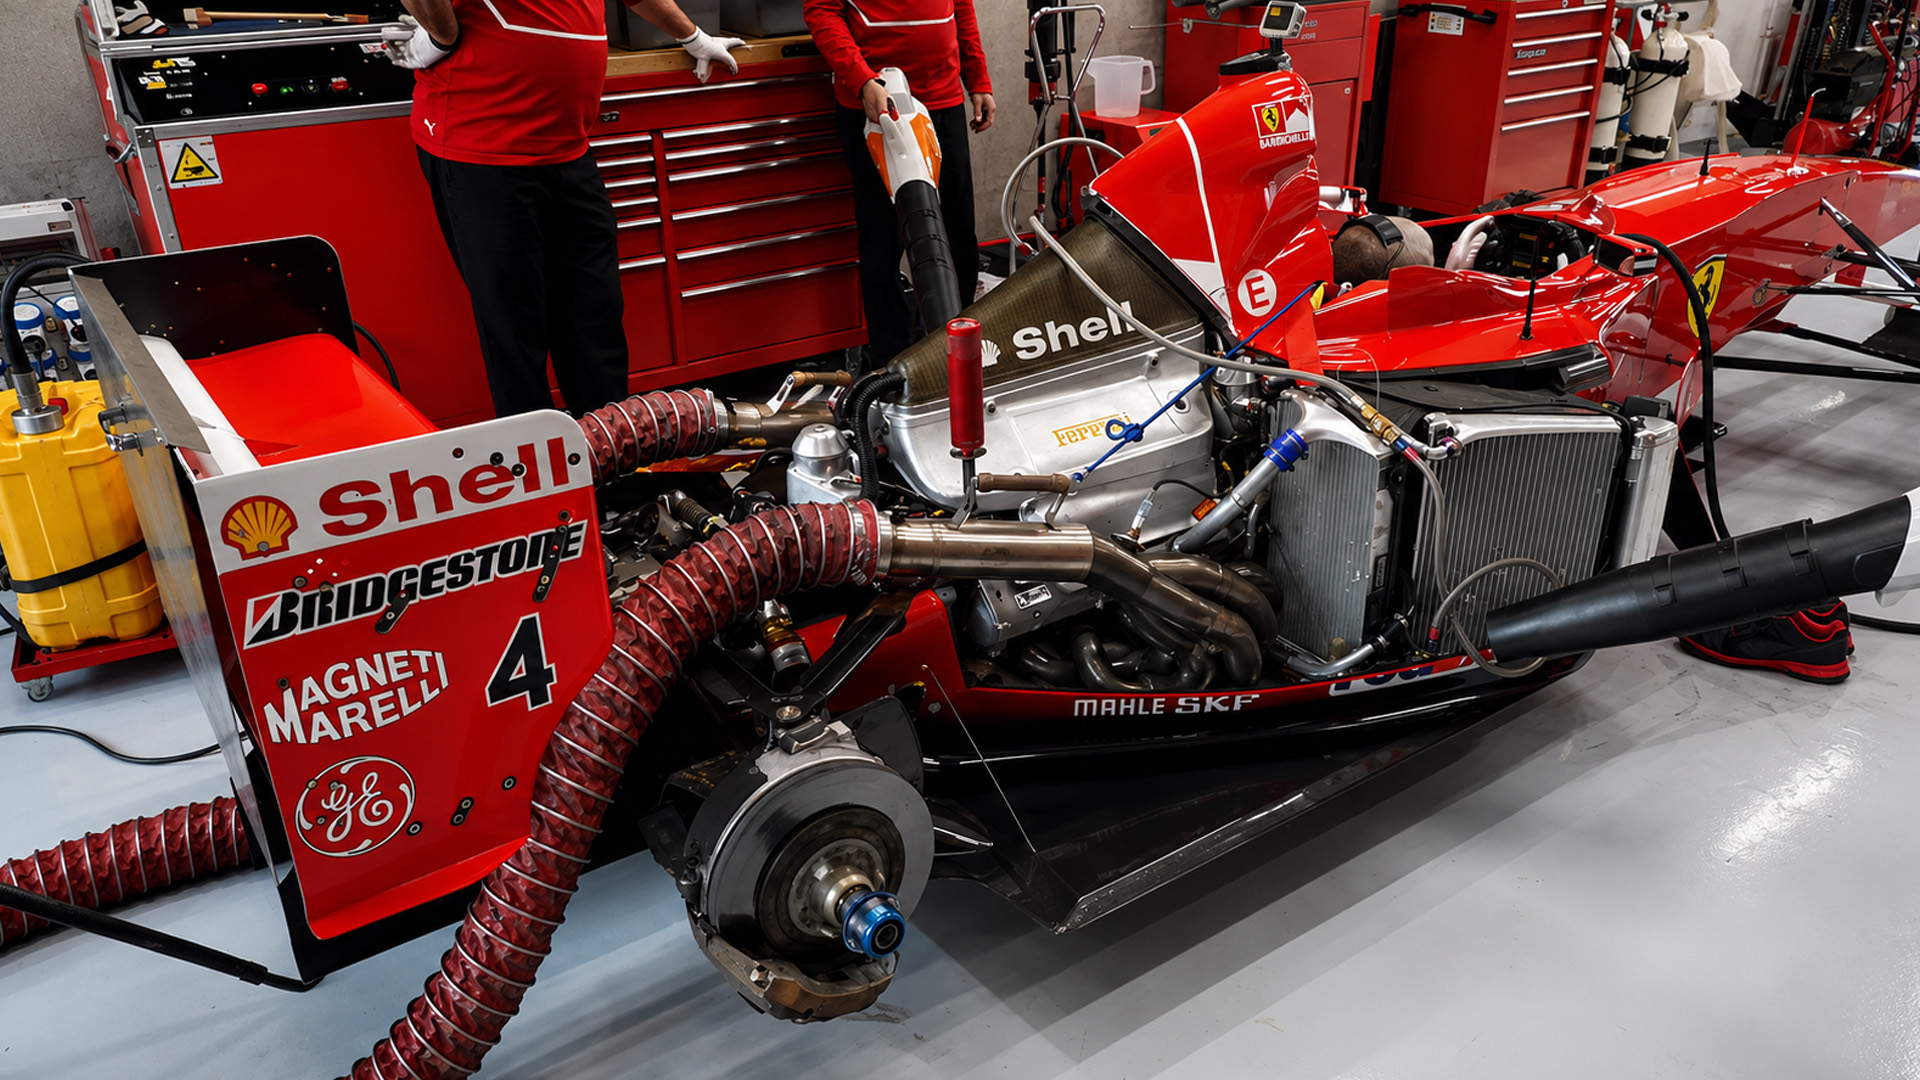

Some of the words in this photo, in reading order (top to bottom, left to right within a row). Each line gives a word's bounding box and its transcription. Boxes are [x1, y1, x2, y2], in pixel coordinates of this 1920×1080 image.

[1012, 300, 1136, 361] Shell
[1244, 273, 1272, 312] E
[319, 436, 570, 537] Shell
[243, 519, 588, 650] BRIDGESTONE
[263, 650, 450, 728] MAGNETI
[485, 611, 558, 712] 4
[263, 670, 450, 744] MARELLI
[1073, 697, 1166, 717] MAHLE
[1174, 693, 1260, 714] SKF
